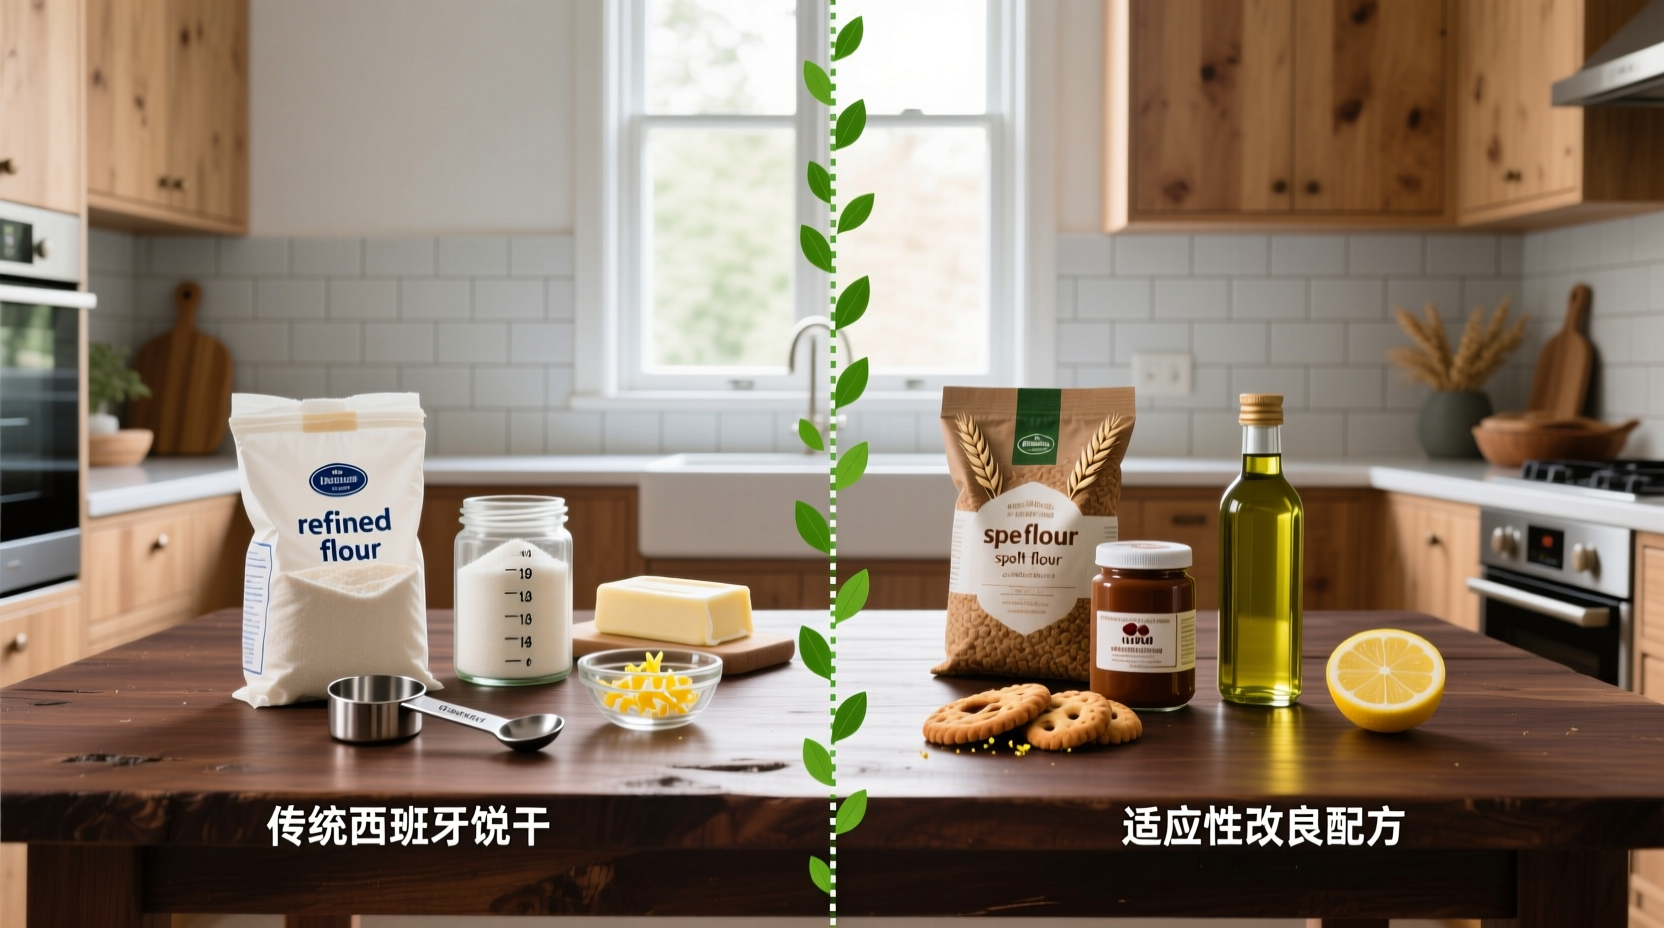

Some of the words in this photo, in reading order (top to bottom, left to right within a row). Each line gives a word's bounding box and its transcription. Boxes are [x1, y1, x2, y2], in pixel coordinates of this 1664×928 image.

[298, 508, 392, 535] refined
[320, 539, 382, 562] flour
[1031, 551, 1064, 566] flour
